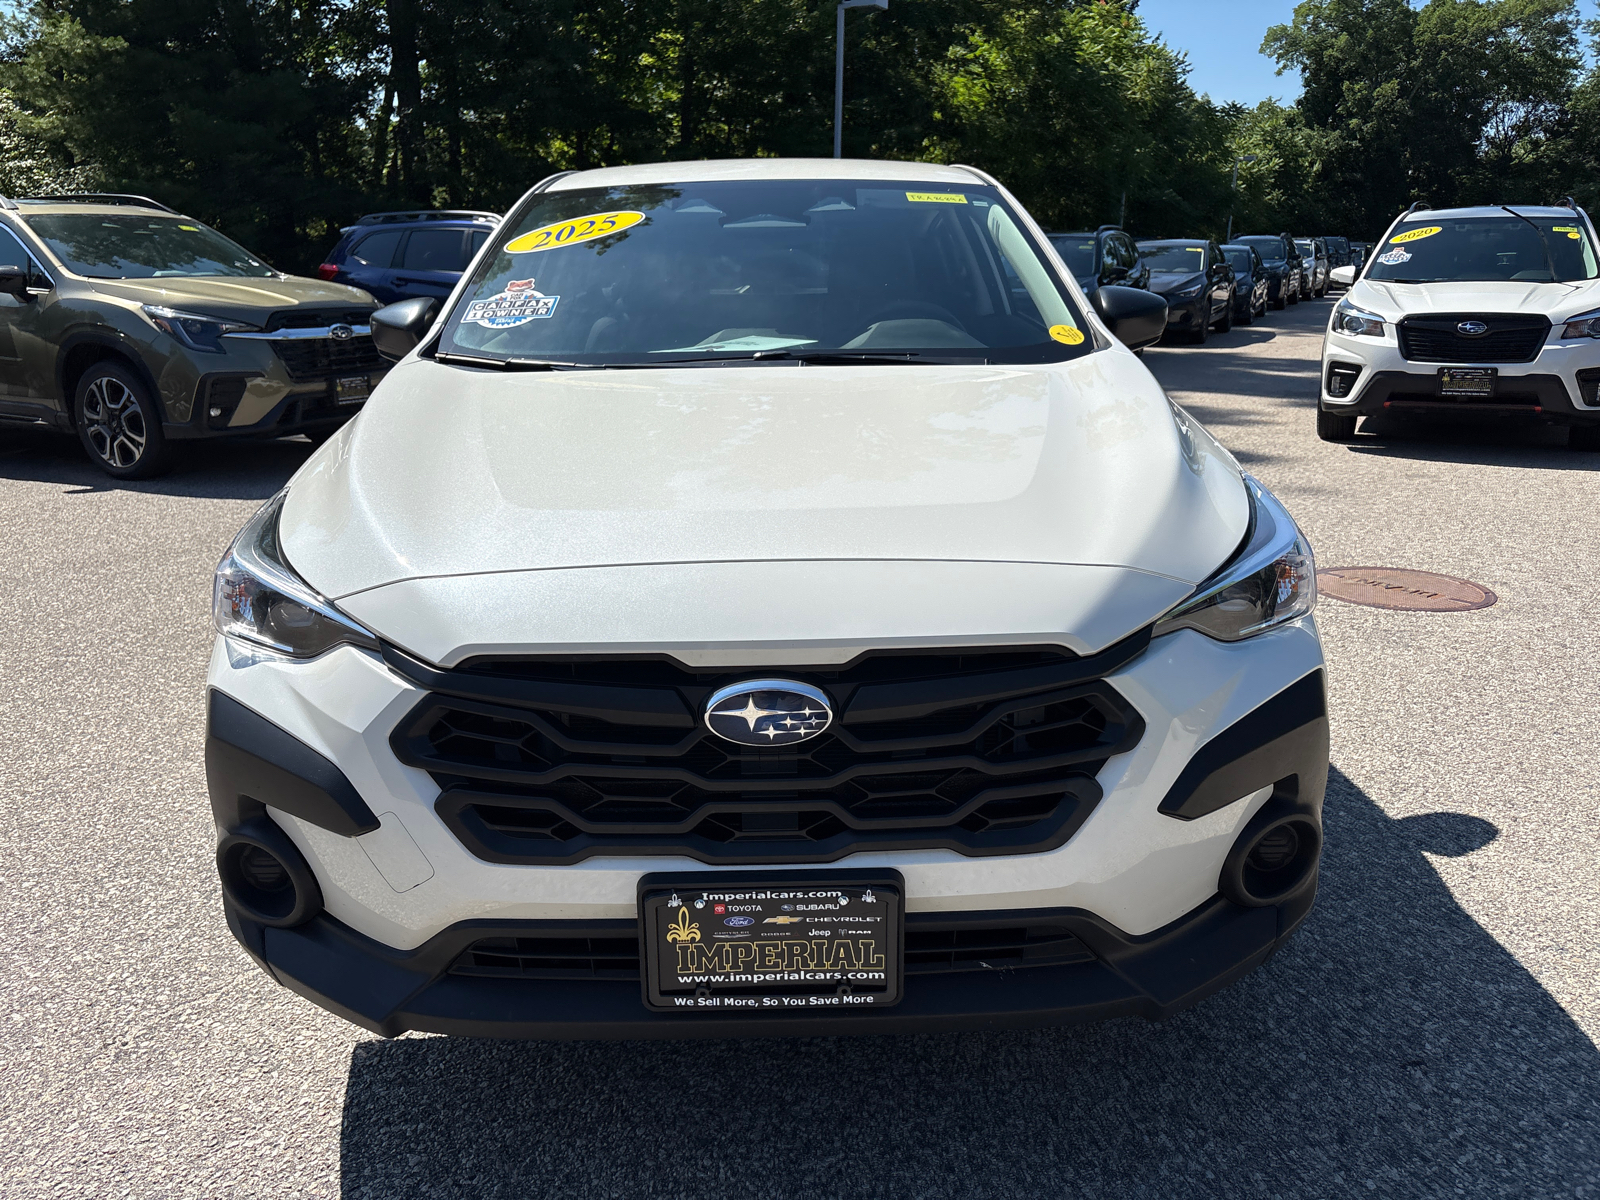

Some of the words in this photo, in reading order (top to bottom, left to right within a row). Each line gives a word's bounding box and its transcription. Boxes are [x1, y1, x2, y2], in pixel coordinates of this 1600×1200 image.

[530, 214, 619, 250] 2025
[1399, 228, 1433, 241] 2020
[474, 300, 551, 311] CARFAX
[483, 308, 547, 318] OWNER
[702, 890, 842, 902] Imperialcars.com
[727, 904, 763, 912] TOYOTA
[796, 903, 840, 911] SUBARU
[729, 918, 749, 926] Ford
[808, 928, 831, 937] Jeep
[676, 939, 885, 974] IMPERIAL
[677, 970, 886, 984] www.imperialcars.com
[674, 997, 695, 1007] We
[698, 997, 720, 1006] Sell
[724, 997, 760, 1008] More,
[762, 997, 779, 1006] So
[782, 997, 806, 1006] You
[809, 996, 839, 1005] Save
[843, 994, 874, 1004] More
